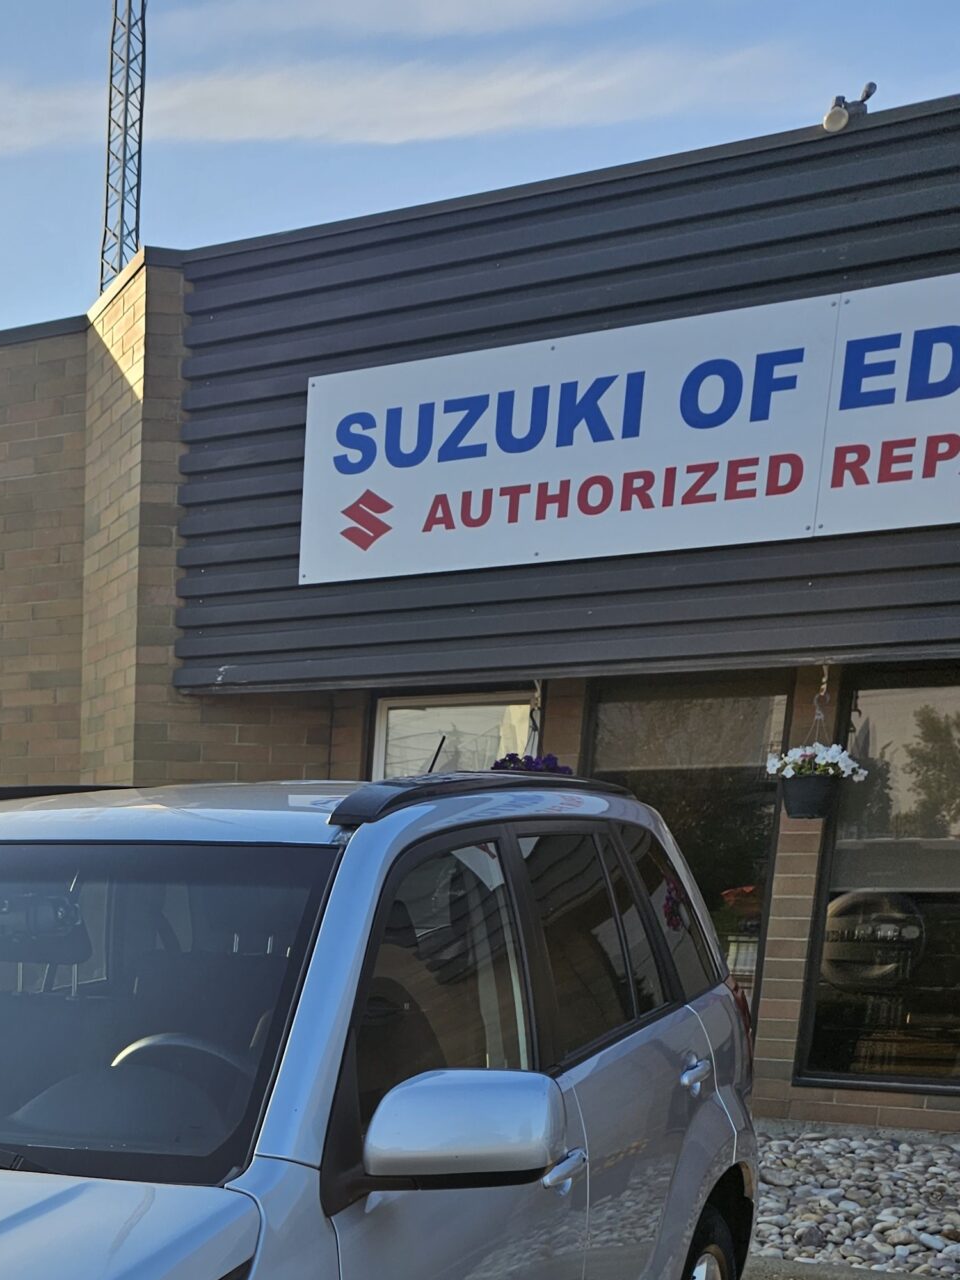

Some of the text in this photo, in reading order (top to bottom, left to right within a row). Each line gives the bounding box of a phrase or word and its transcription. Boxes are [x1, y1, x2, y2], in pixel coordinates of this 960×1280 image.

[332, 324, 960, 476] SUZUKI OF ED
[422, 453, 804, 532] AUTHORIZED
